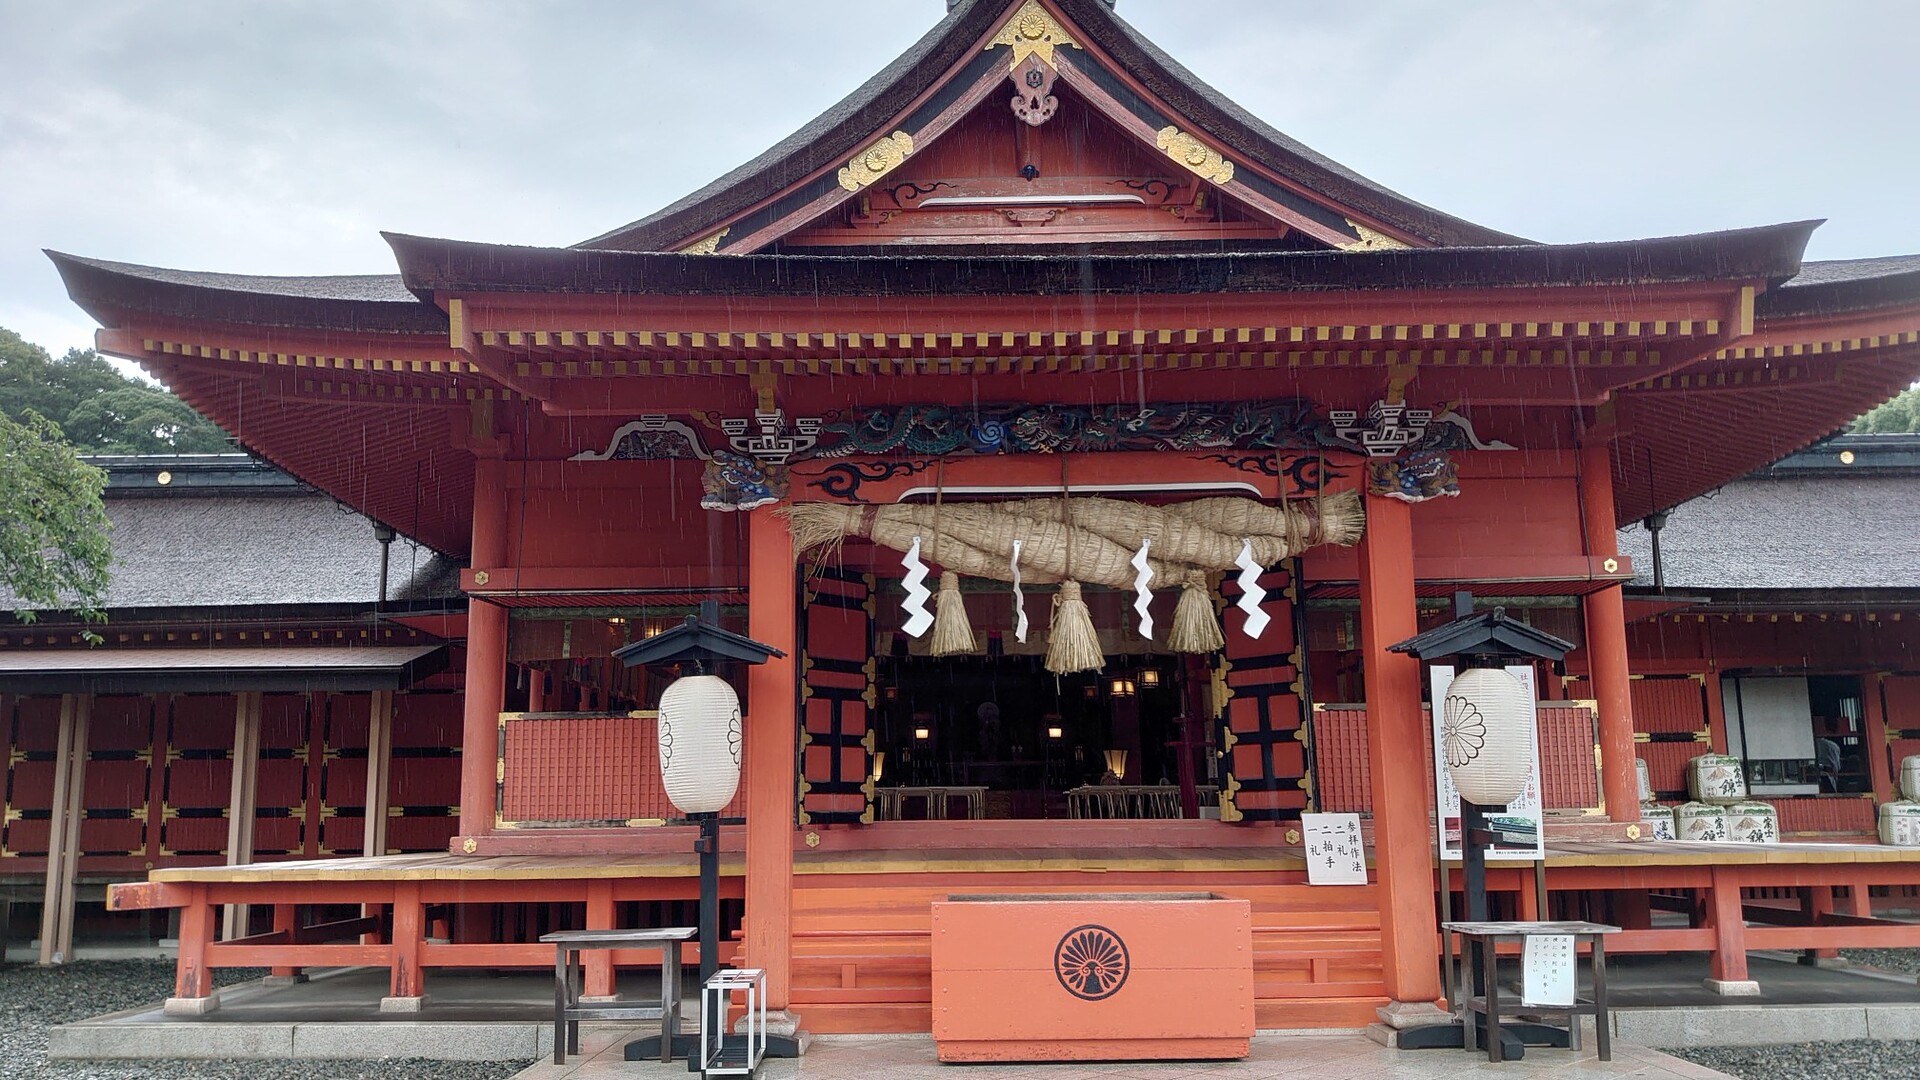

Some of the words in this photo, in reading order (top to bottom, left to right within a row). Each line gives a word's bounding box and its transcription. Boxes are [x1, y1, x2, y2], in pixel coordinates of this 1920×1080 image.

[1307, 828, 1321, 856] 一礼
[1321, 825, 1335, 868] 二拍手
[1335, 825, 1348, 856] 二礼
[1347, 820, 1362, 872] 参拝作法
